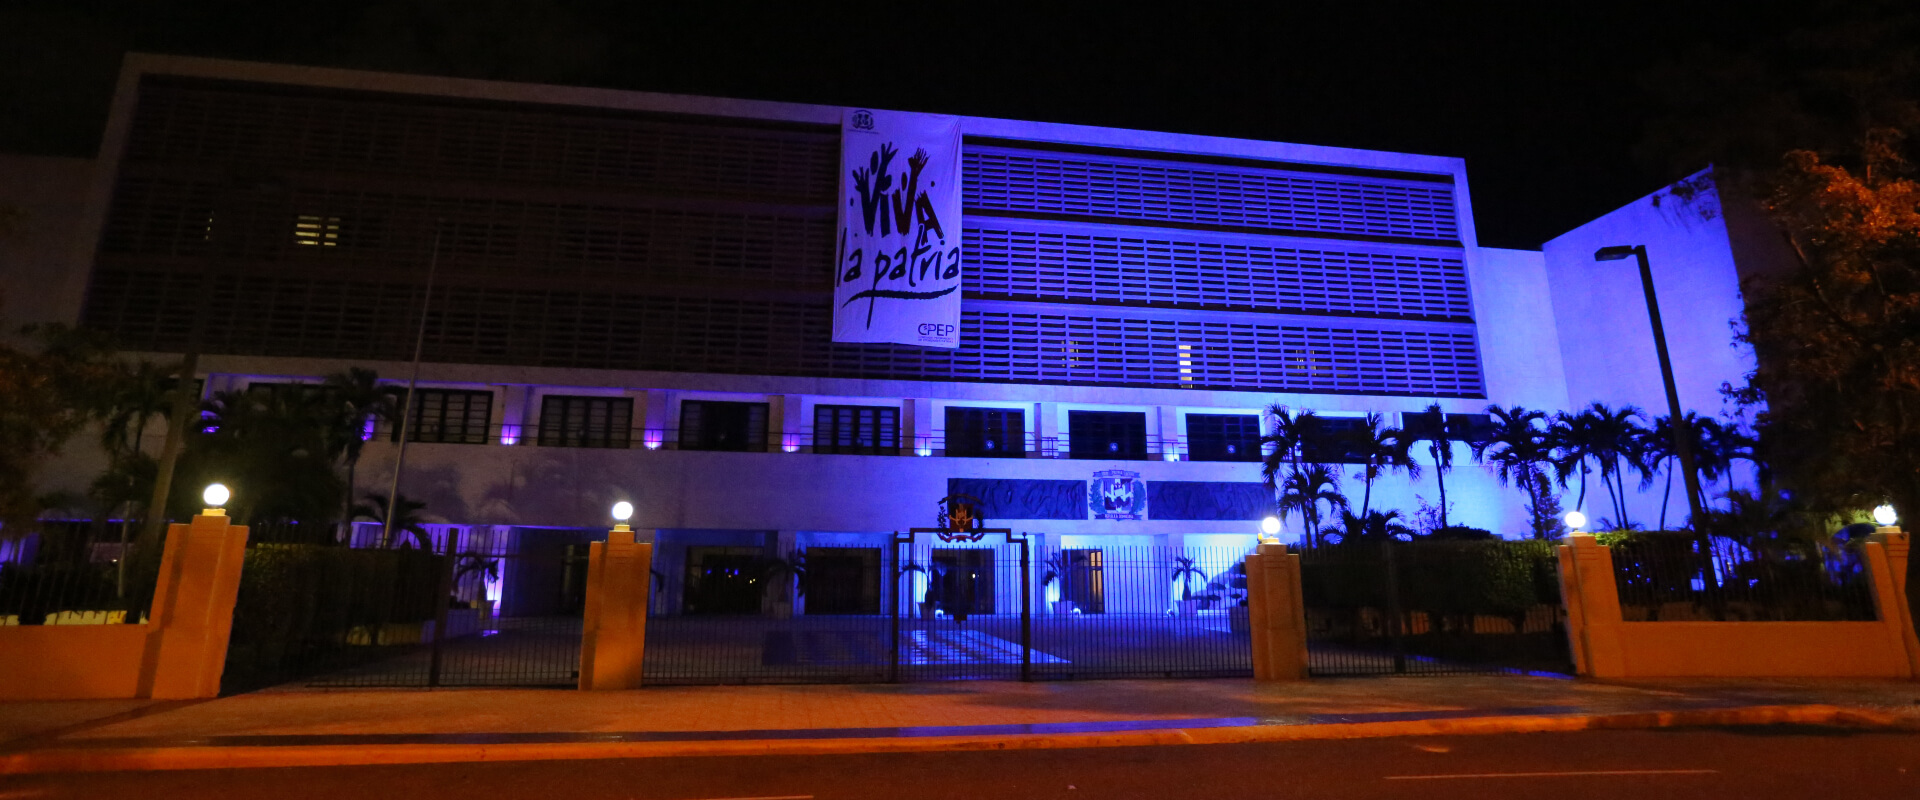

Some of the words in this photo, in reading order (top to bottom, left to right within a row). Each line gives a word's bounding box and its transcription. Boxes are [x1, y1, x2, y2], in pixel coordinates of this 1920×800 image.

[852, 142, 944, 245] VIVA
[836, 227, 862, 288] la
[866, 224, 960, 331] patria
